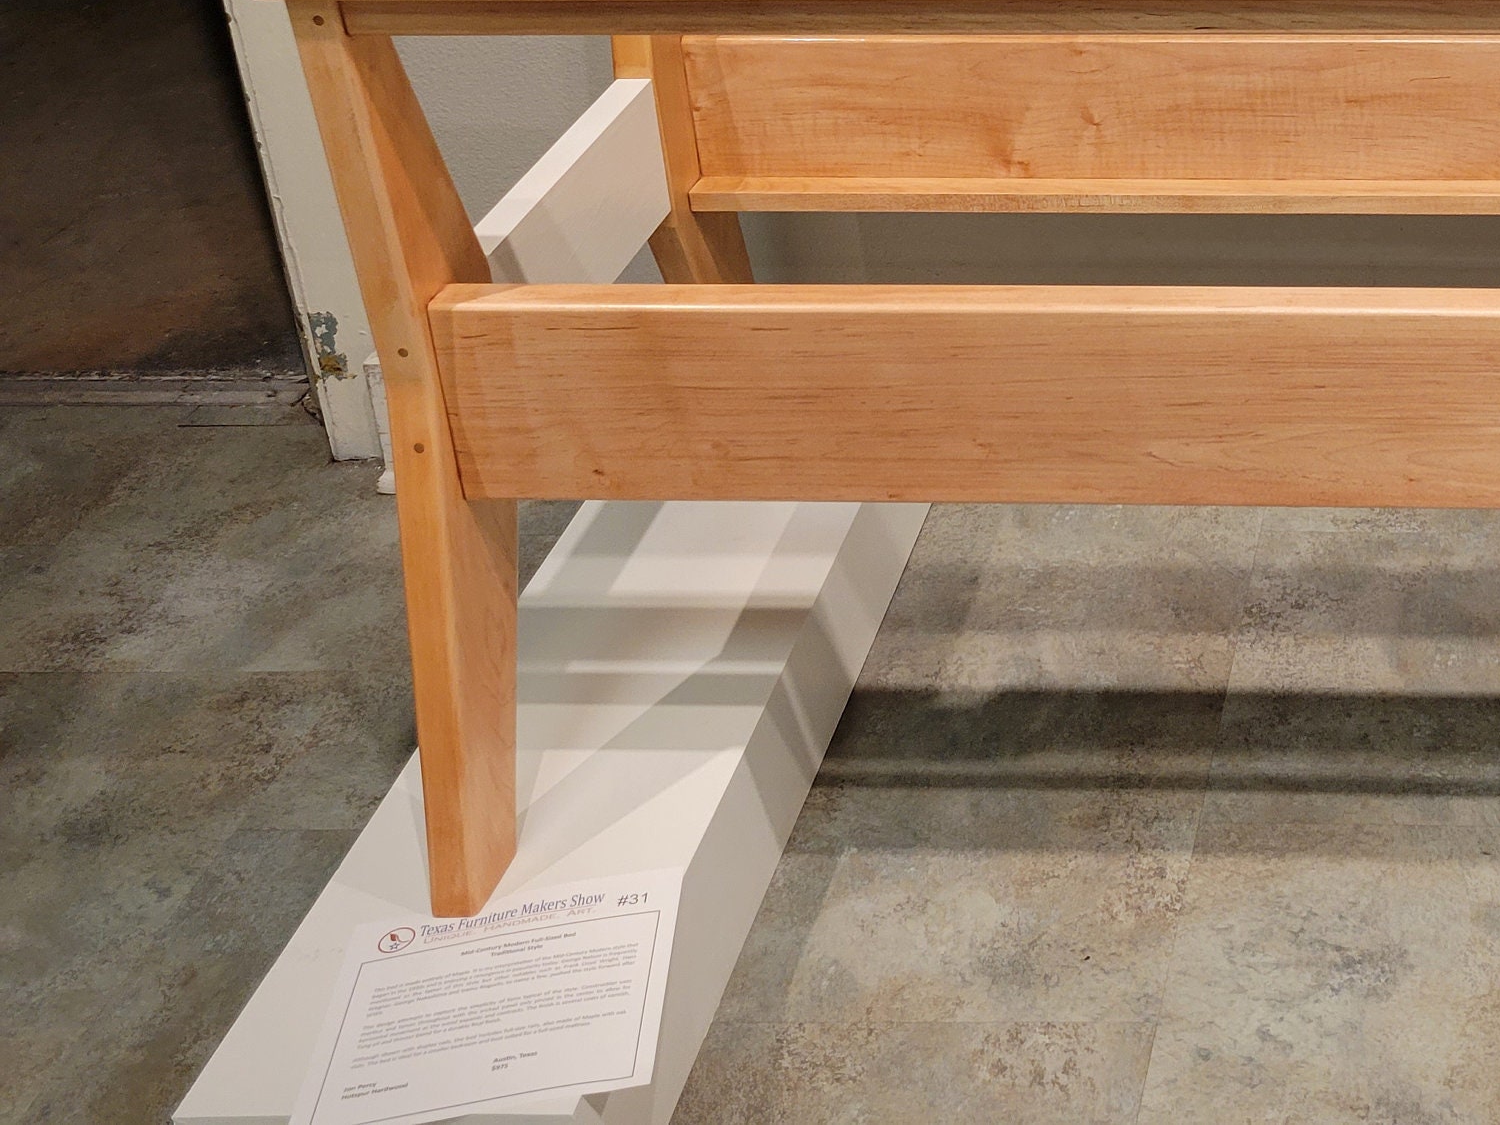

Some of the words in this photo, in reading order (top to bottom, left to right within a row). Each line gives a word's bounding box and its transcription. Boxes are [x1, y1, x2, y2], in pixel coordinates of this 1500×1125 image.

[617, 891, 649, 907] #31
[420, 921, 456, 937] Texas
[457, 908, 518, 931] Furniture
[521, 898, 568, 915] Makers
[569, 892, 606, 908] Show
